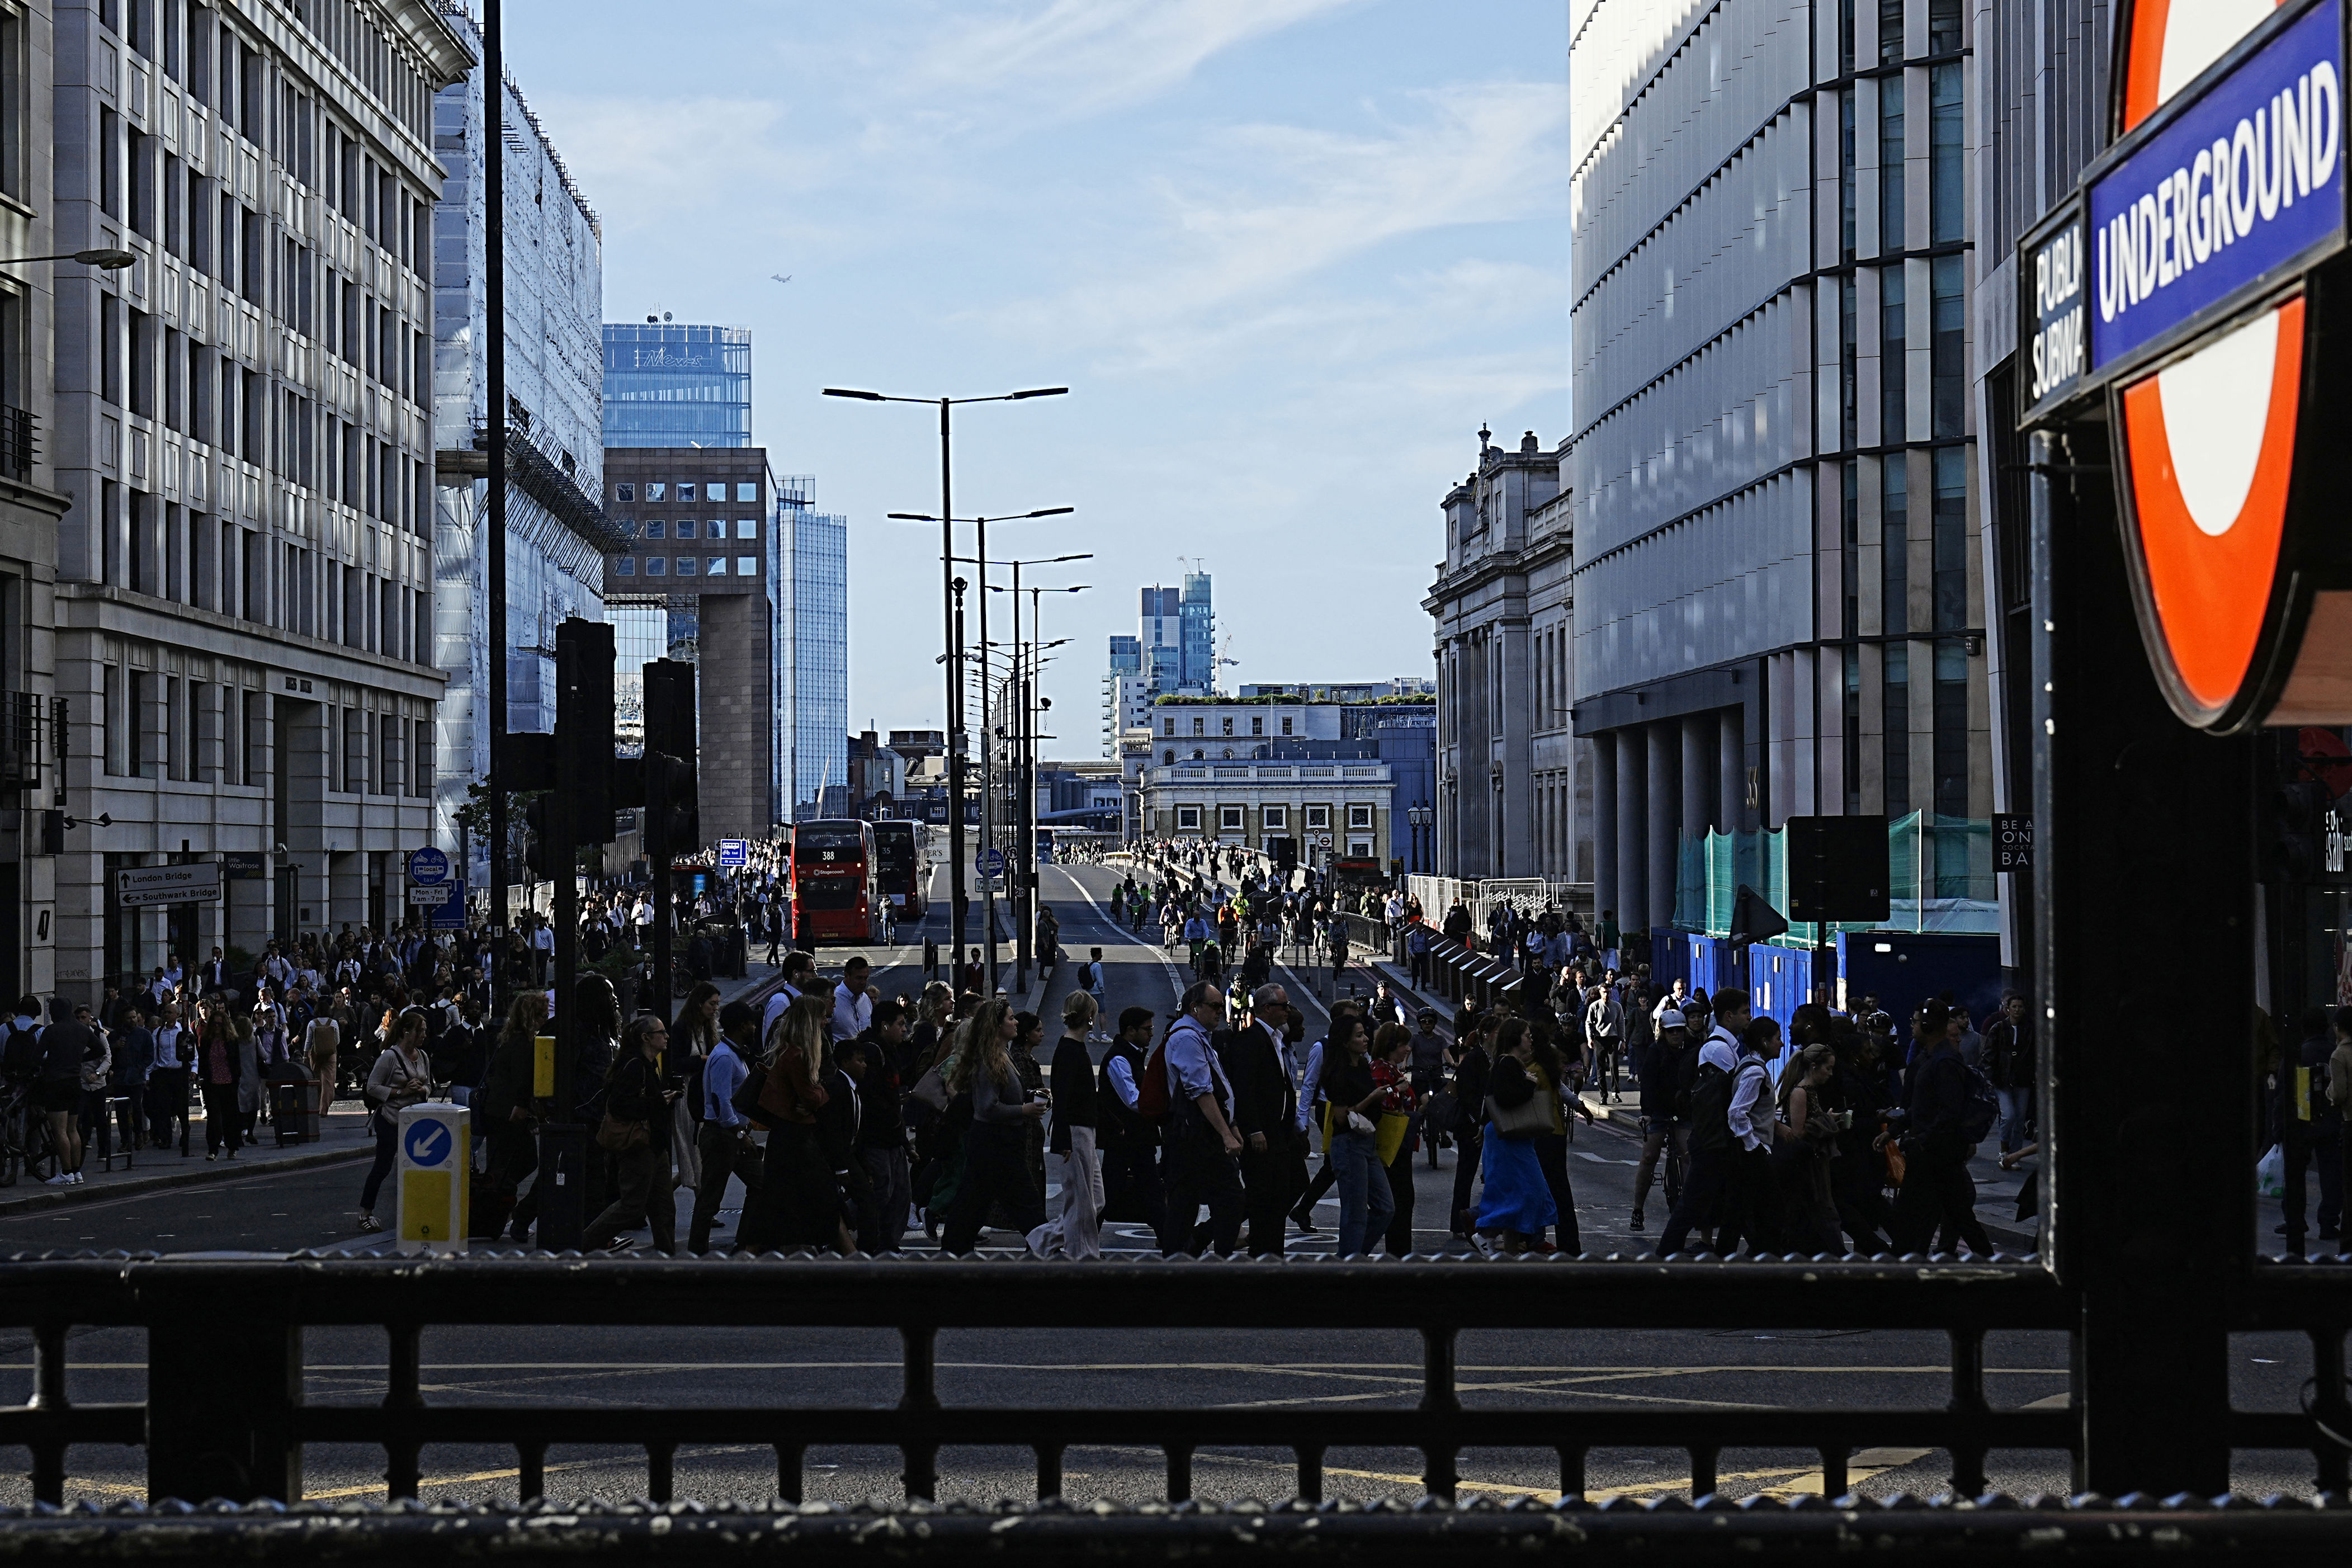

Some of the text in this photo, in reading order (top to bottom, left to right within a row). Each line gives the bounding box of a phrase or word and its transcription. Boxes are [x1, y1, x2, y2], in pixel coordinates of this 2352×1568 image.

[2098, 59, 2339, 323] UNDERGROUND
[643, 346, 703, 367] News
[2032, 304, 2083, 400] SUBWA
[2001, 820, 2018, 830] BE
[822, 851, 835, 861] 388
[2001, 852, 2029, 865] BA
[133, 872, 192, 883] London Bridge
[143, 889, 218, 901] Southwark Bridge
[496, 927, 500, 936] 1
